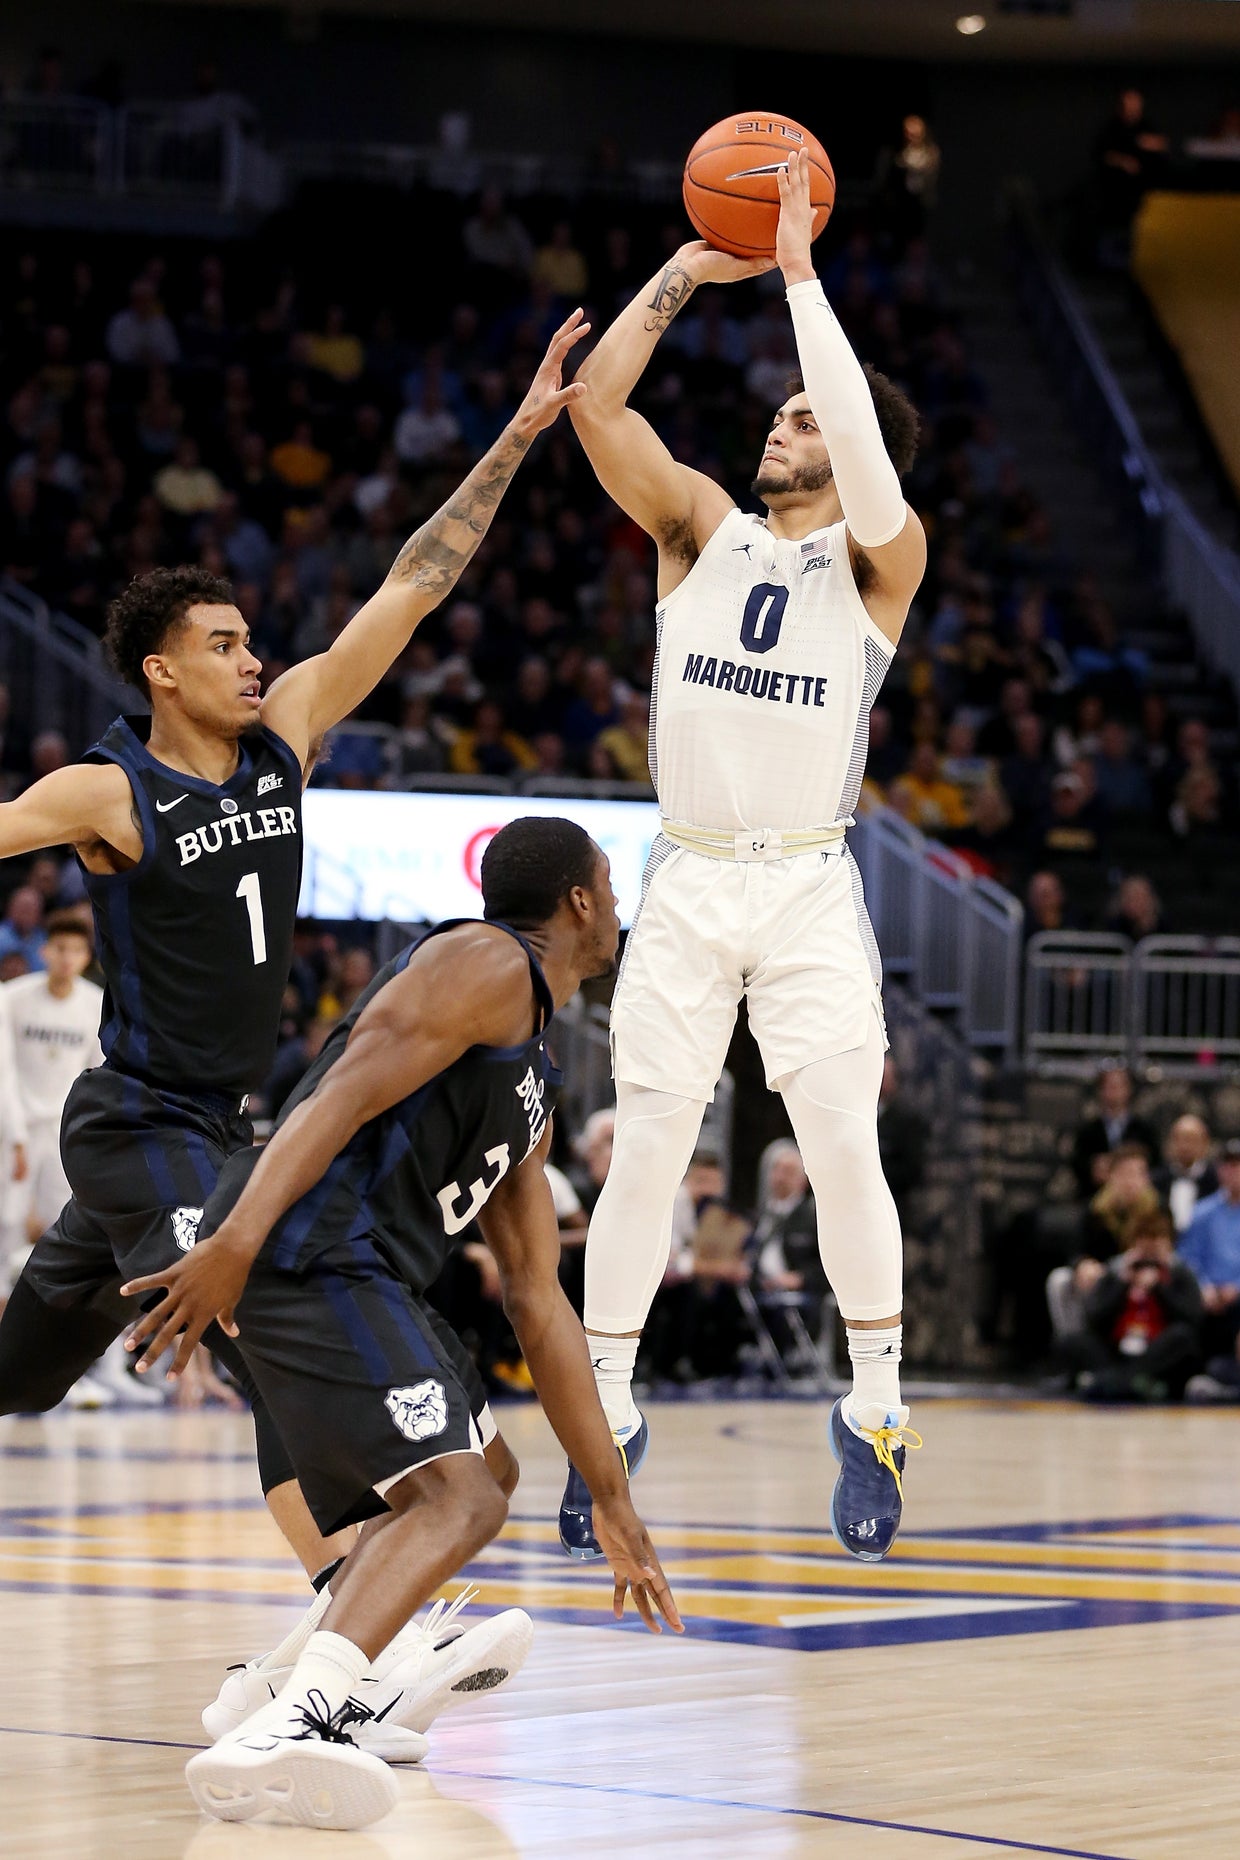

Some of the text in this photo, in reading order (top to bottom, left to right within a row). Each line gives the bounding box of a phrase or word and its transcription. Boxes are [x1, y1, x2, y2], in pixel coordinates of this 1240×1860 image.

[736, 122, 803, 144] ELITE
[804, 559, 833, 571] EAST
[806, 555, 826, 566] BIG
[739, 582, 790, 654] 0
[682, 653, 828, 708] MARQUETTE
[257, 777, 283, 792] EAST
[258, 773, 276, 786] BIG
[175, 806, 297, 866] BUTLER
[236, 872, 267, 966] 1
[436, 1143, 510, 1236] 3
